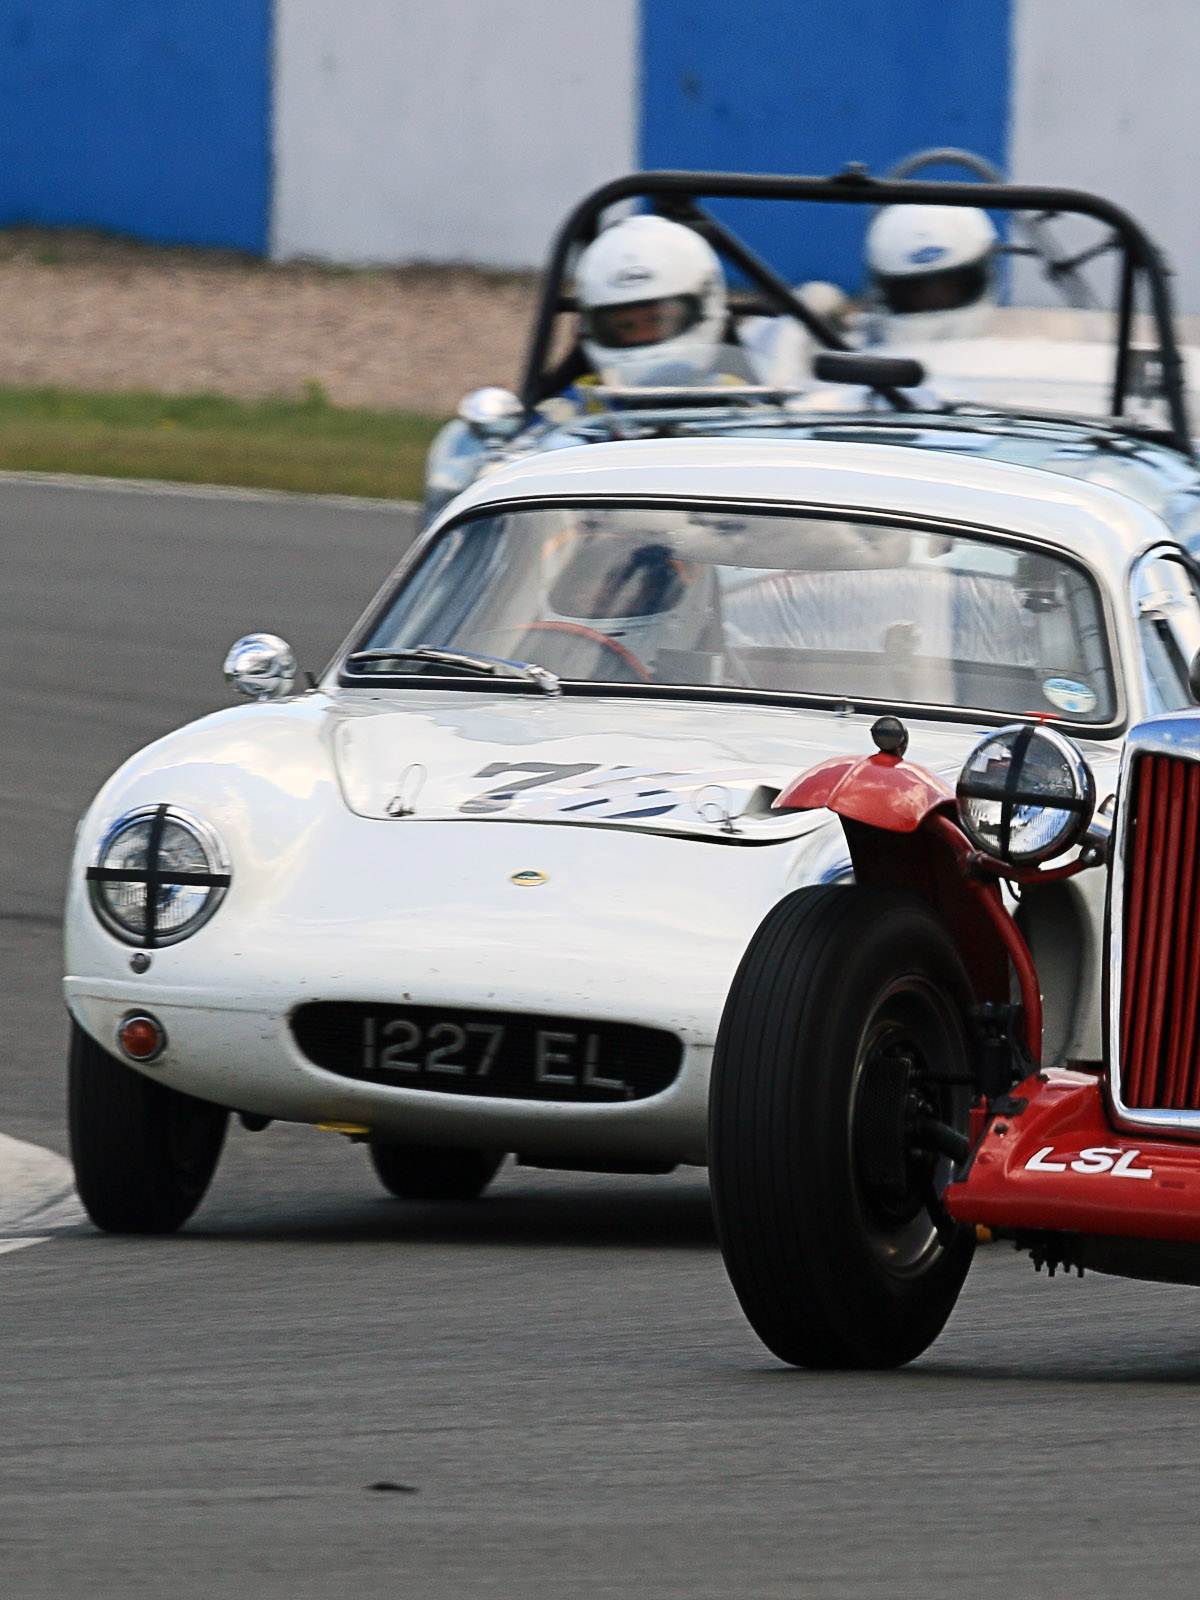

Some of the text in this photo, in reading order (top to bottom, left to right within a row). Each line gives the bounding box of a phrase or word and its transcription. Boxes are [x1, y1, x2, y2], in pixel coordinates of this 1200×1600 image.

[363, 1017, 626, 1090] 1227 EL
[1024, 1146, 1153, 1180] LSL
